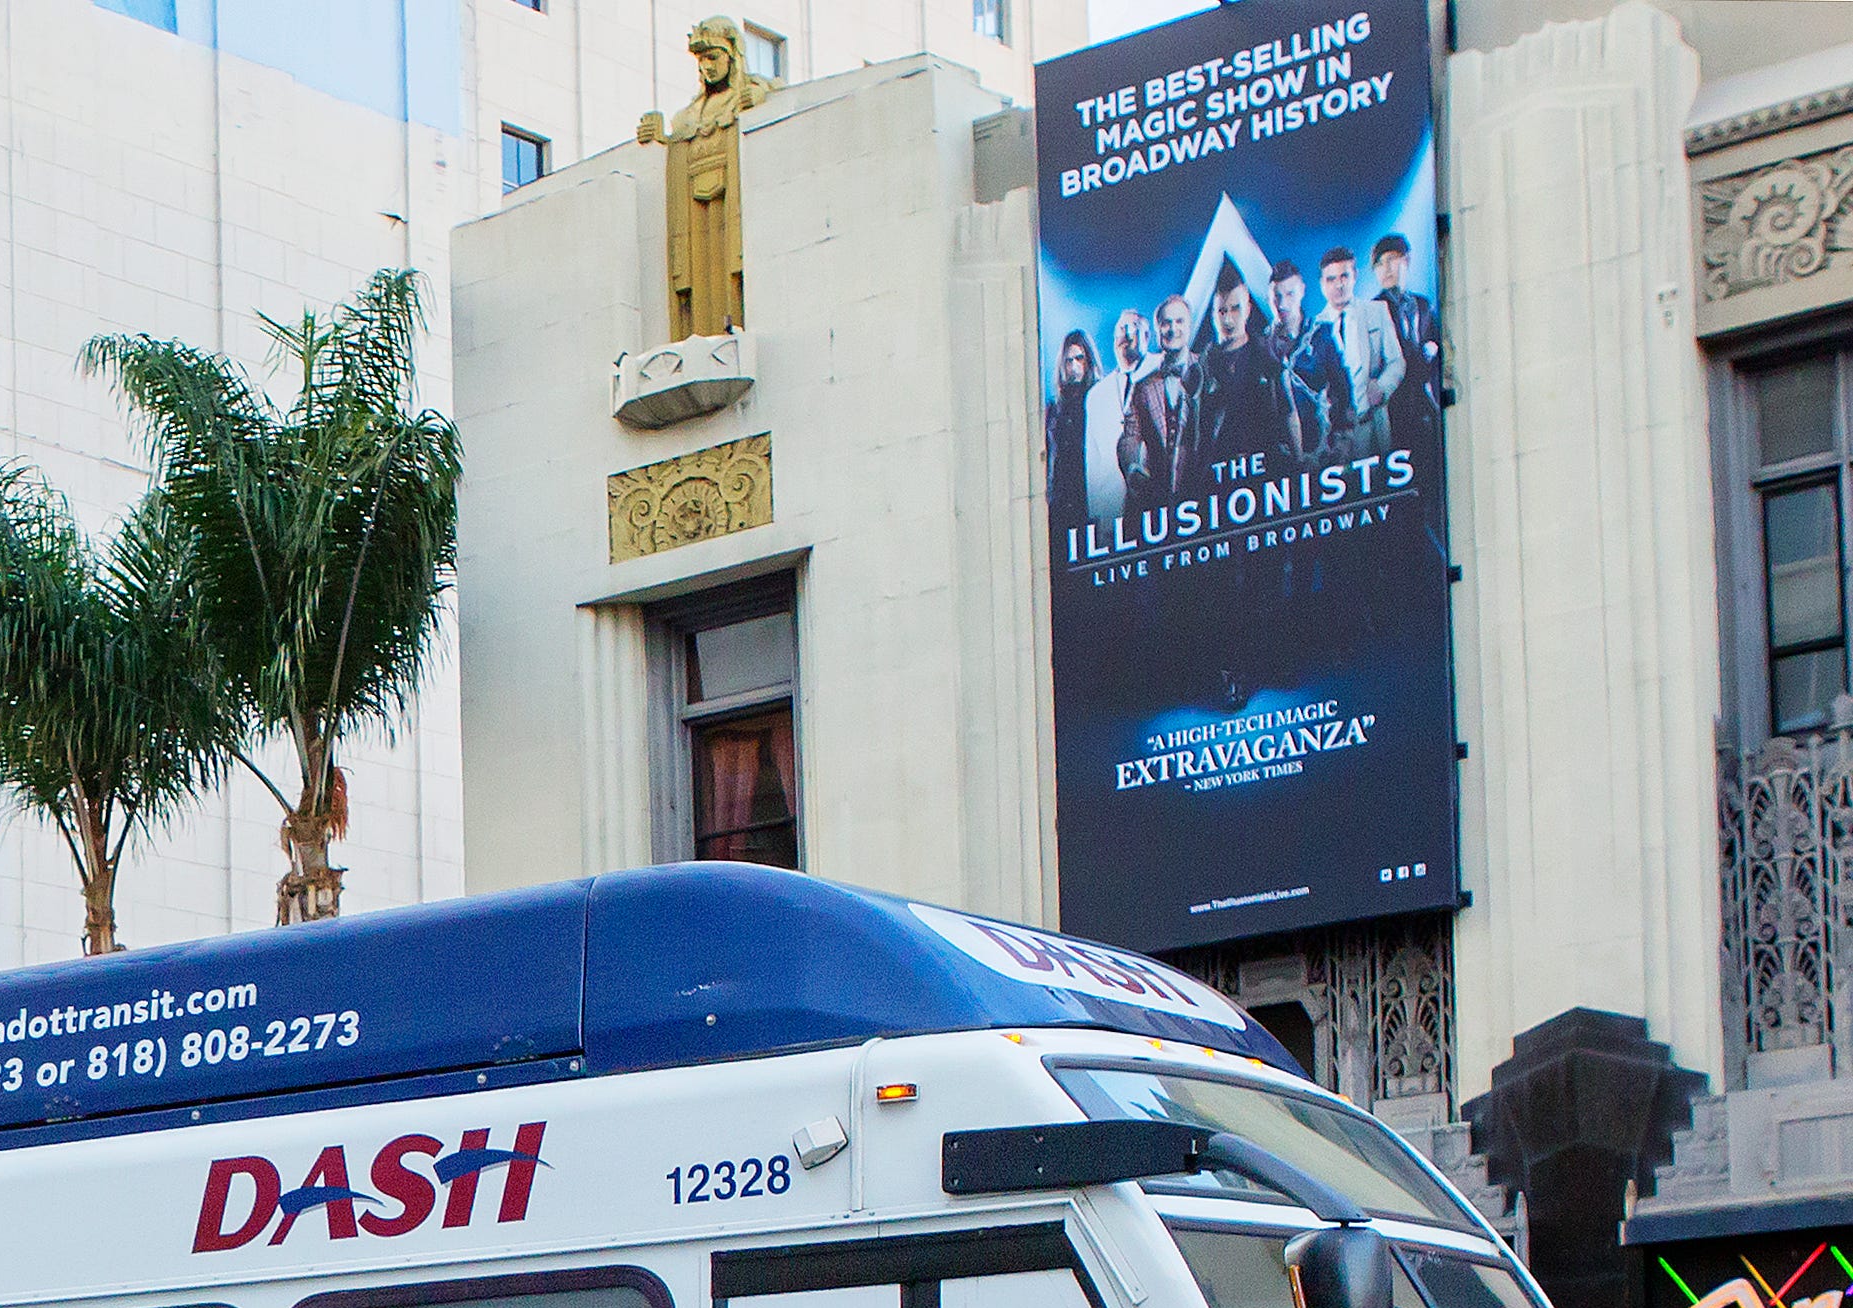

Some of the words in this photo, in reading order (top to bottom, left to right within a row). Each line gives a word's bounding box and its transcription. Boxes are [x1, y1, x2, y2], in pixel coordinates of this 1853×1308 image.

[1076, 86, 1138, 129] THE
[1144, 11, 1372, 103] BEST-SELLING
[1095, 101, 1198, 156] MAGIC
[1206, 69, 1306, 122] SHOW
[1315, 52, 1352, 87] IN
[1060, 121, 1240, 199] BROADWAY
[1251, 71, 1395, 142] HISTORY
[1067, 448, 1415, 562] ILLUSIONISTS
[1211, 452, 1266, 484] THE
[1093, 560, 1148, 588] LIVE
[1163, 540, 1231, 571] FROM
[1247, 503, 1391, 553] BROADWAY
[1167, 711, 1273, 748] HIGH-TECH
[1276, 700, 1339, 727] MAGIC
[1193, 776, 1224, 793] NEW
[1225, 767, 1260, 786] YORK
[1263, 760, 1304, 779] TIMES
[964, 918, 1200, 1008] DASH
[36, 1059, 76, 1087] or
[87, 1040, 167, 1082] 818)
[180, 1010, 362, 1068] 808-2273
[191, 1121, 551, 1254] DASH
[665, 1153, 791, 1205] 12328
